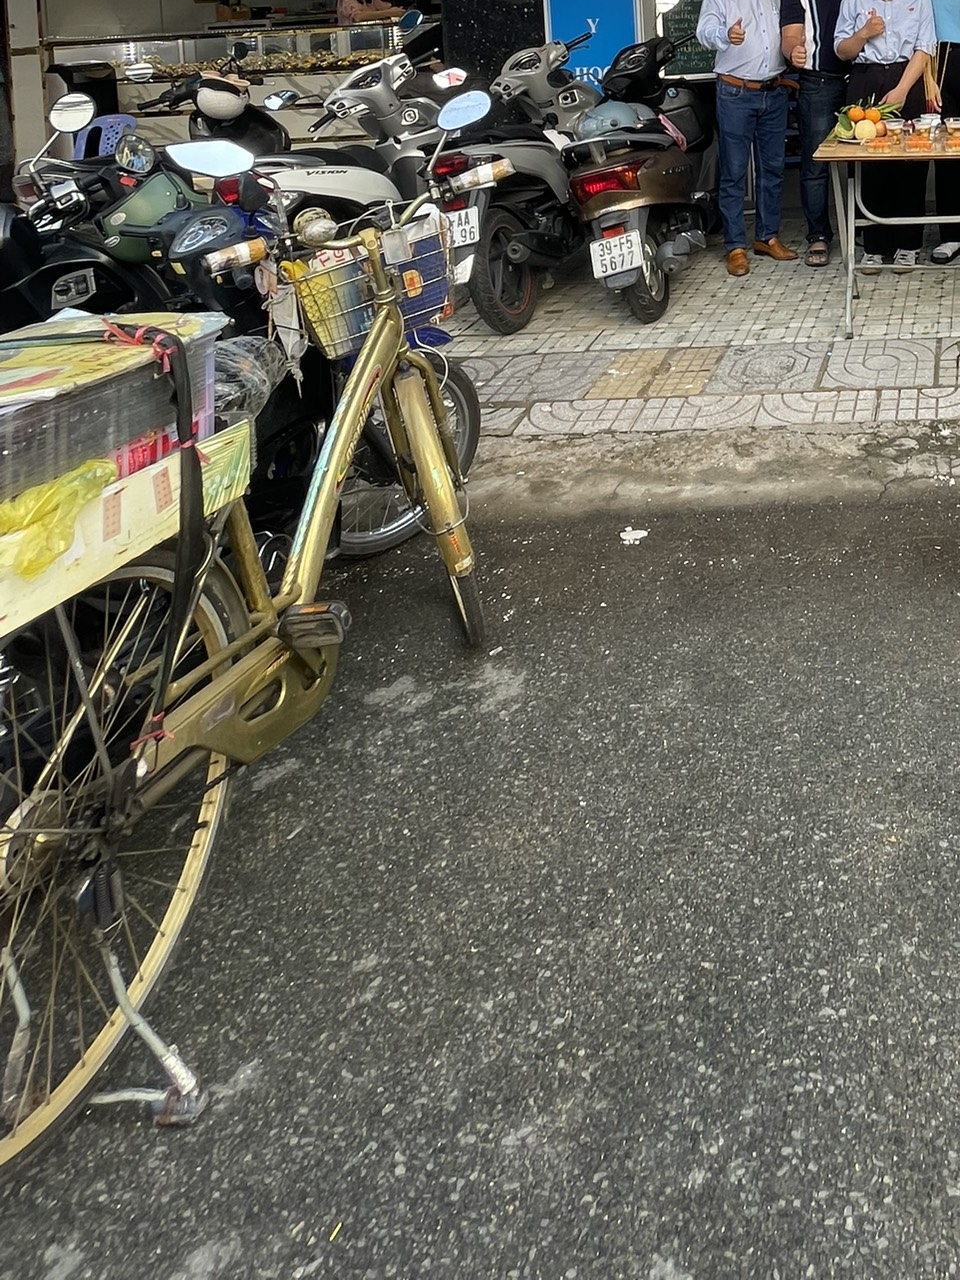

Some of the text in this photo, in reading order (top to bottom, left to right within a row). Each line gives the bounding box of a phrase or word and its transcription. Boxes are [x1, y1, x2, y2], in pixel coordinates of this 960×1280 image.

[586, 18, 599, 34] Y
[598, 235, 633, 257] 39-F5
[601, 251, 635, 274] 5677
